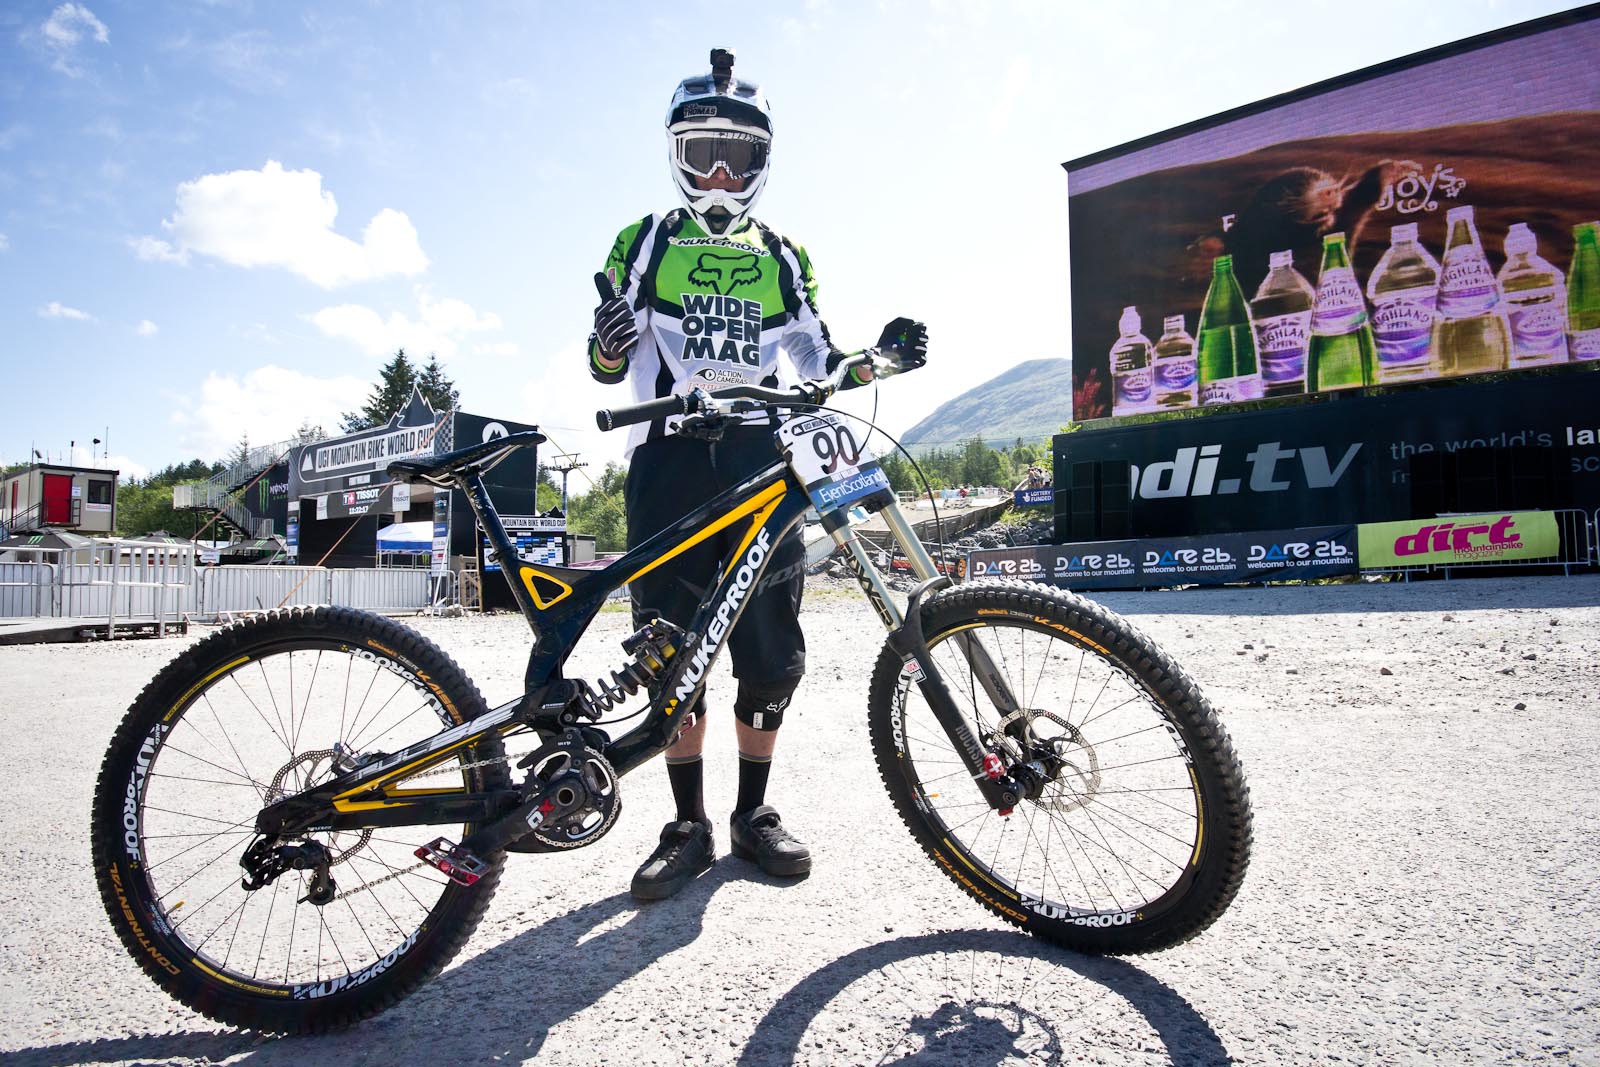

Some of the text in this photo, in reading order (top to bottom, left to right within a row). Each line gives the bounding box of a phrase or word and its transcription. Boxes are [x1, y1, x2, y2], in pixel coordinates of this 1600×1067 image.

[678, 238, 769, 256] NUKEPROOF
[682, 294, 761, 322] WIDE
[682, 315, 760, 344] OPEN
[682, 337, 760, 366] MAG
[716, 376, 749, 385] CAMERAS
[717, 370, 742, 379] ACTION
[331, 442, 366, 467] MOUNTAIN
[368, 438, 384, 460] BIKE
[388, 432, 415, 455] WORLD
[418, 427, 434, 451] CUP
[812, 426, 860, 474] 90
[1566, 427, 1600, 446] la
[819, 467, 882, 502] EventScotland
[1131, 442, 1363, 500] di.tv
[270, 483, 288, 495] MONST
[356, 489, 380, 500] TISSOT
[502, 518, 566, 527] MOUNTAIN BIKE WORLD CUP
[1394, 515, 1520, 557] dirt
[1143, 565, 1176, 573] welcome
[1200, 563, 1236, 571] mountain
[1247, 560, 1284, 569] welcome
[1312, 556, 1353, 565] mountain
[1454, 550, 1503, 560] magazine
[1104, 568, 1135, 576] mountain
[675, 527, 772, 701] NUKEPROOF
[1034, 616, 1111, 655] KAISER
[933, 847, 1029, 923] CONTINENTAL
[109, 862, 181, 975] CONTINENTAL
